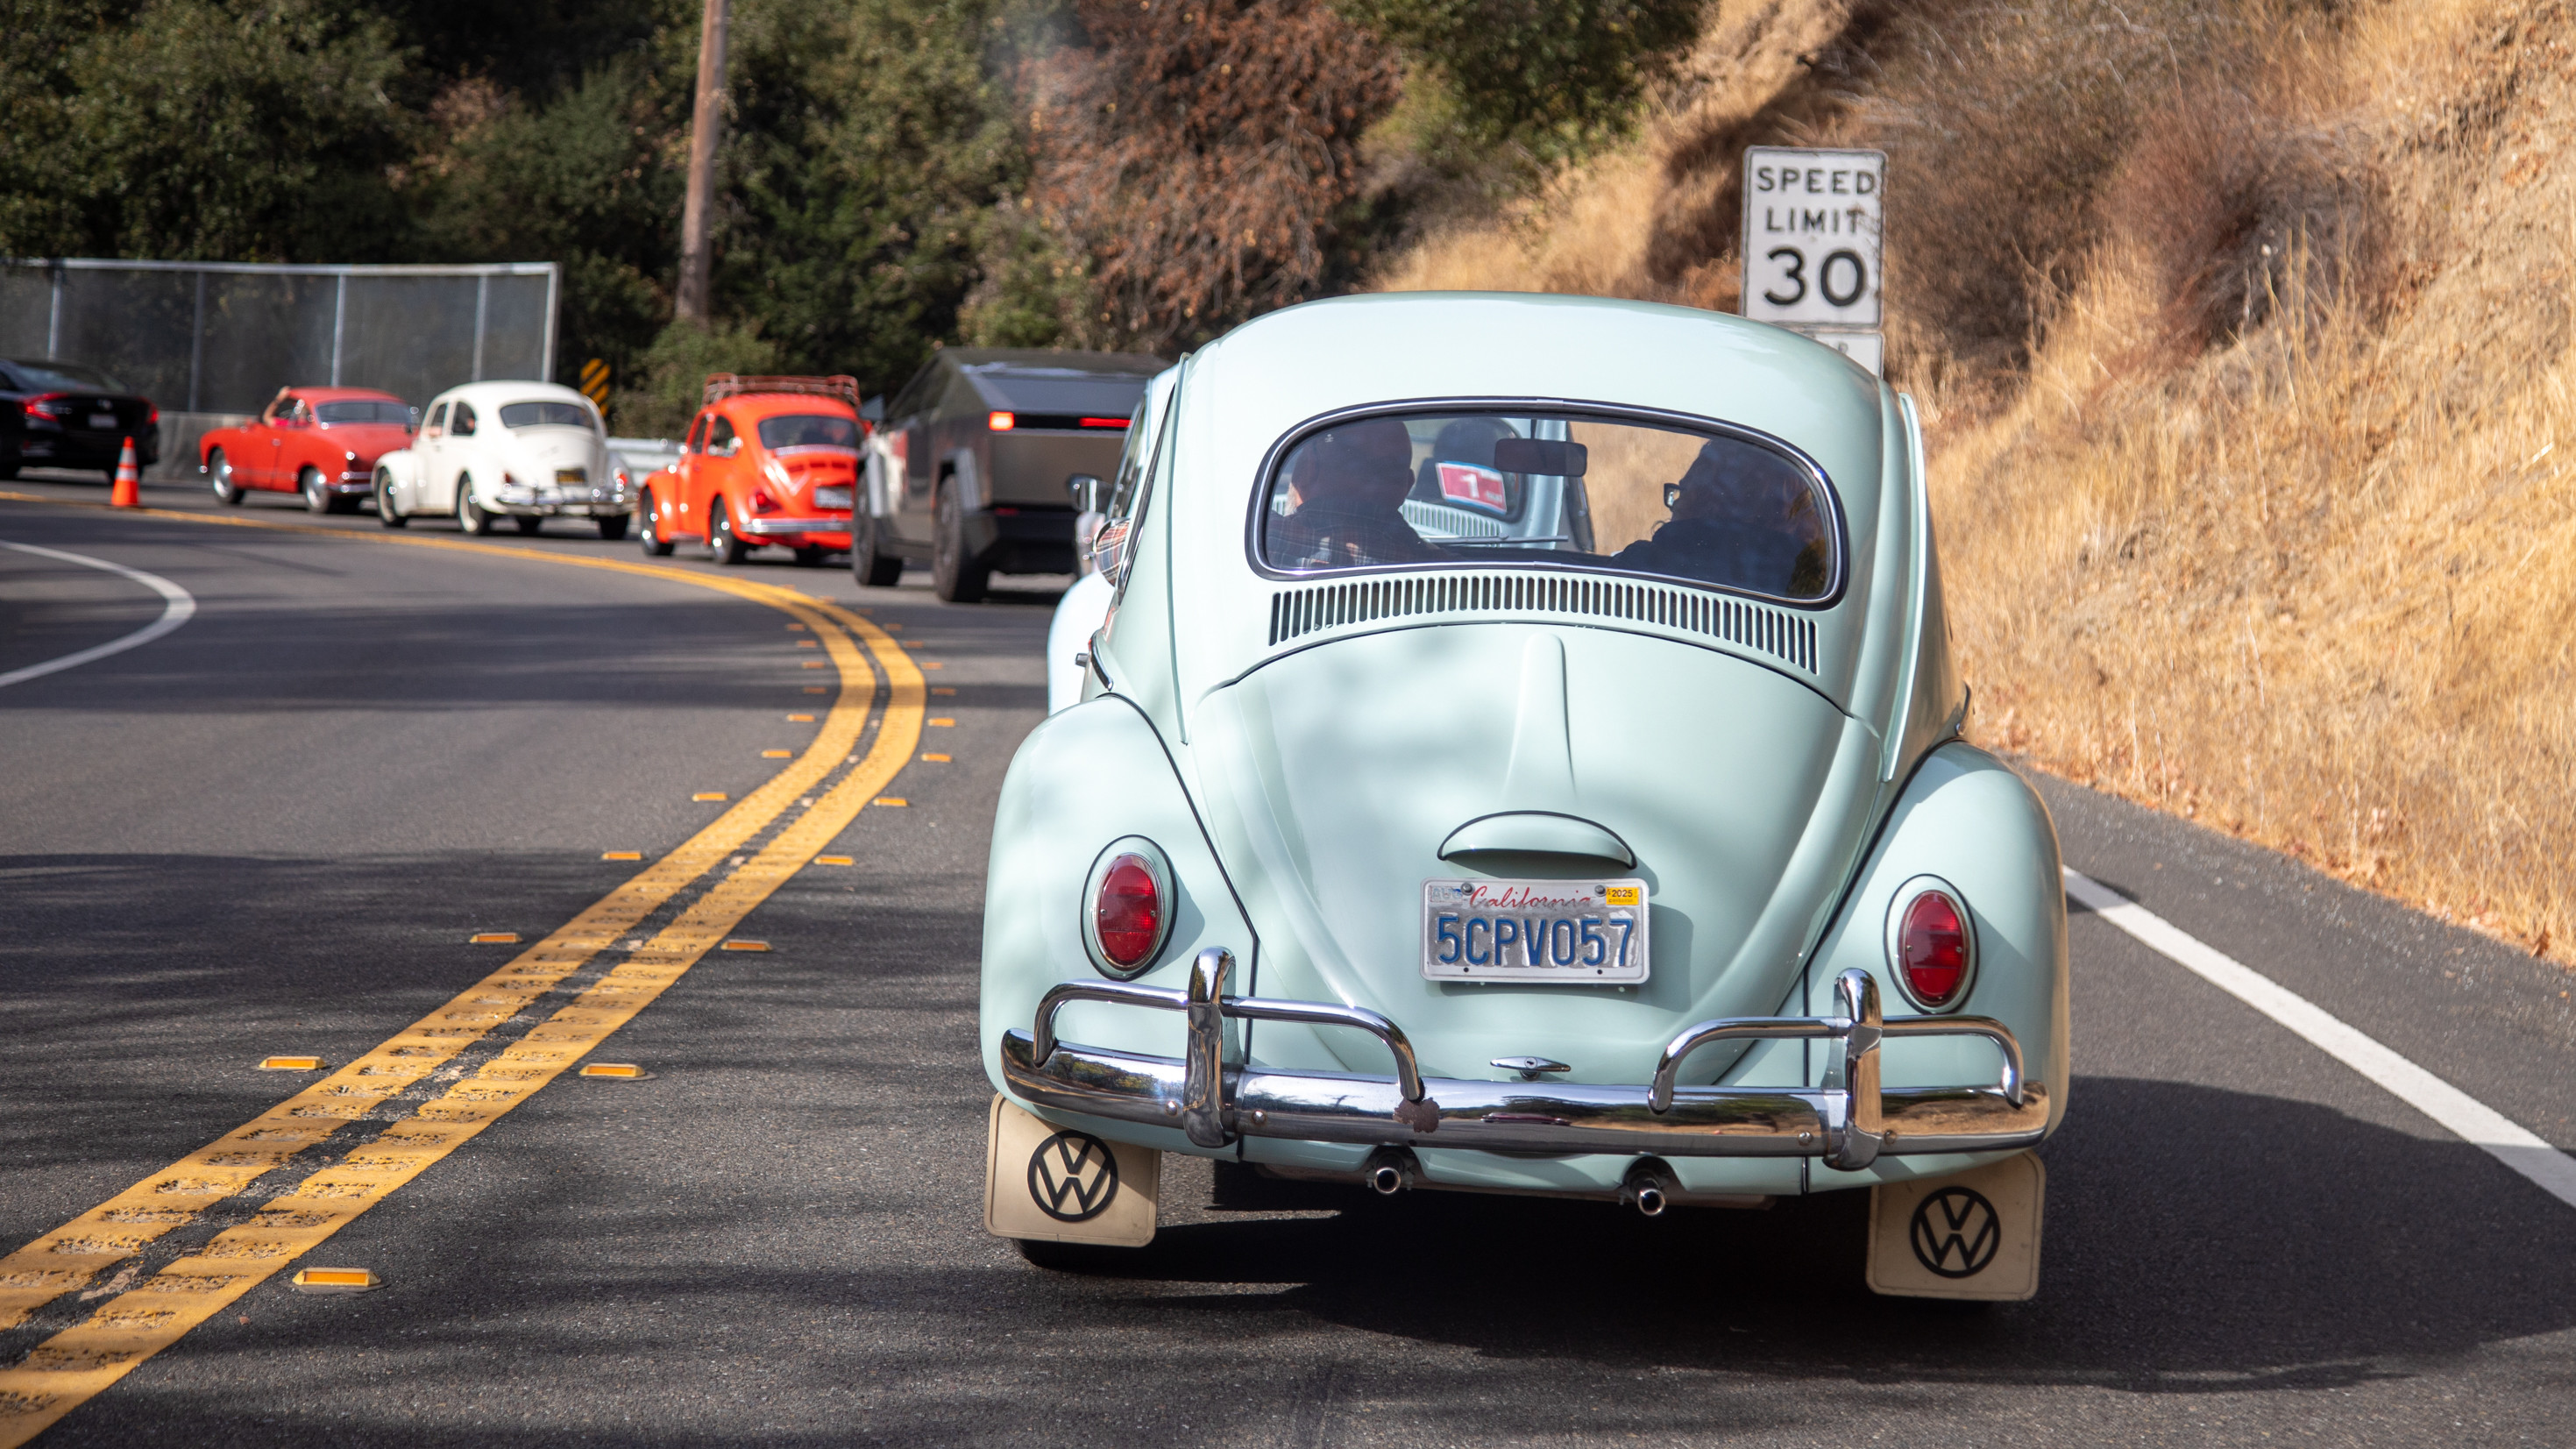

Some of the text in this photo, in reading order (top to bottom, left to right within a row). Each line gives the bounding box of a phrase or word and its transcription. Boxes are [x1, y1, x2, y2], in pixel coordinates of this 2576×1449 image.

[1756, 167, 1875, 195] SPEED
[1765, 207, 1863, 233] LIMIT
[1763, 245, 1867, 307] 30
[1469, 885, 1592, 908] California
[1612, 889, 1633, 898] 2025
[1437, 916, 1634, 967] 5CPV057
